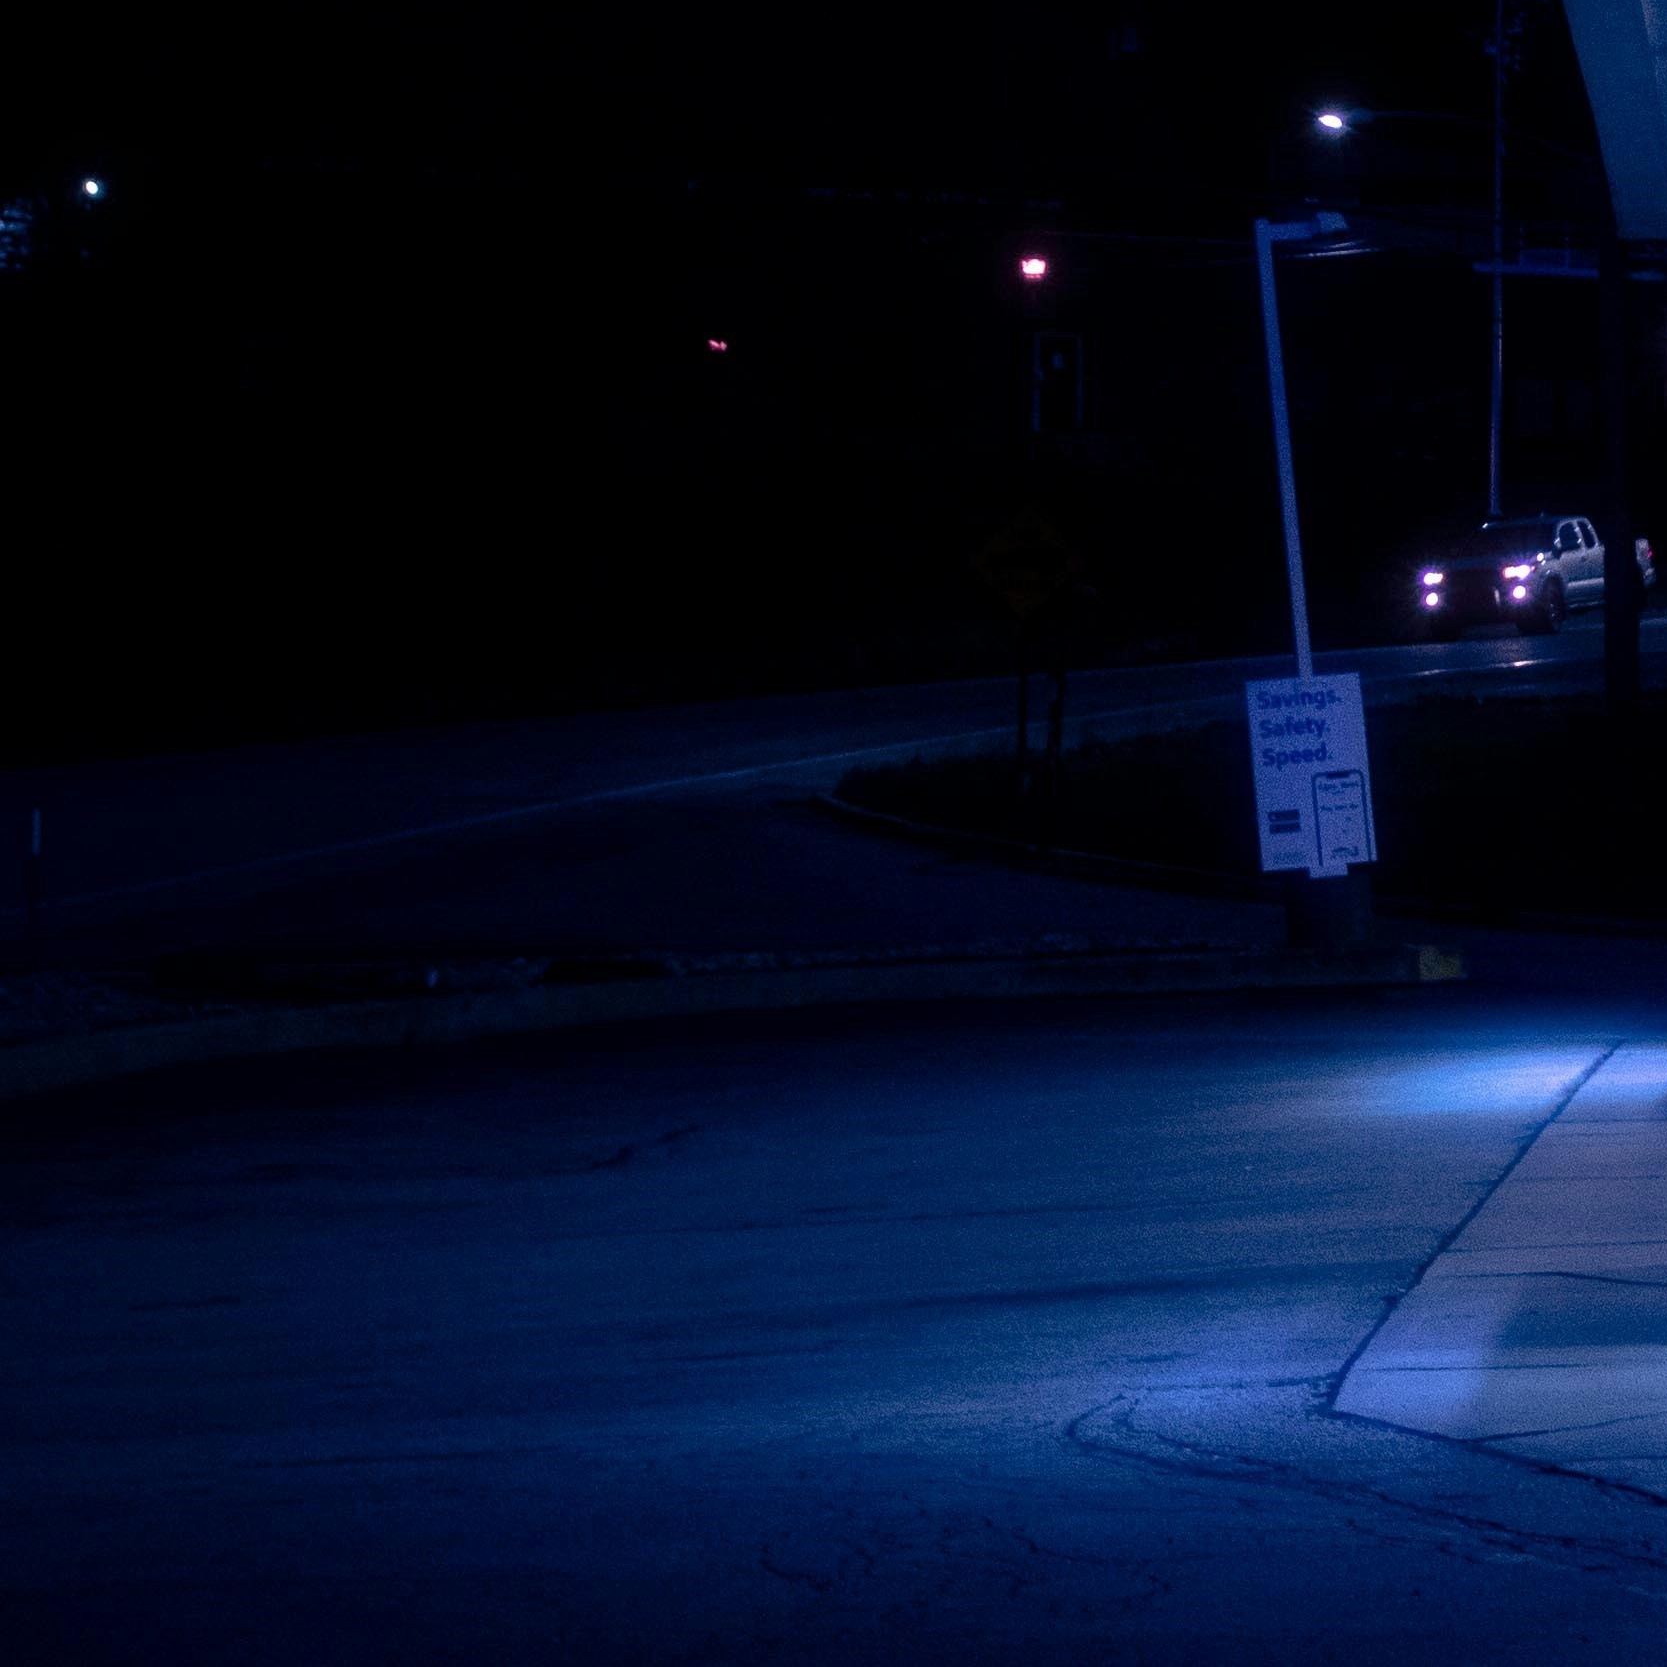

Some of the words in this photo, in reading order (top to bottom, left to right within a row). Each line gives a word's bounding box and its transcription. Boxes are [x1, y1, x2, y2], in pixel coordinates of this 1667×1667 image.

[1256, 689, 1342, 710] Savings.
[1258, 716, 1331, 739] Safety.
[1261, 741, 1334, 771] Speed.
